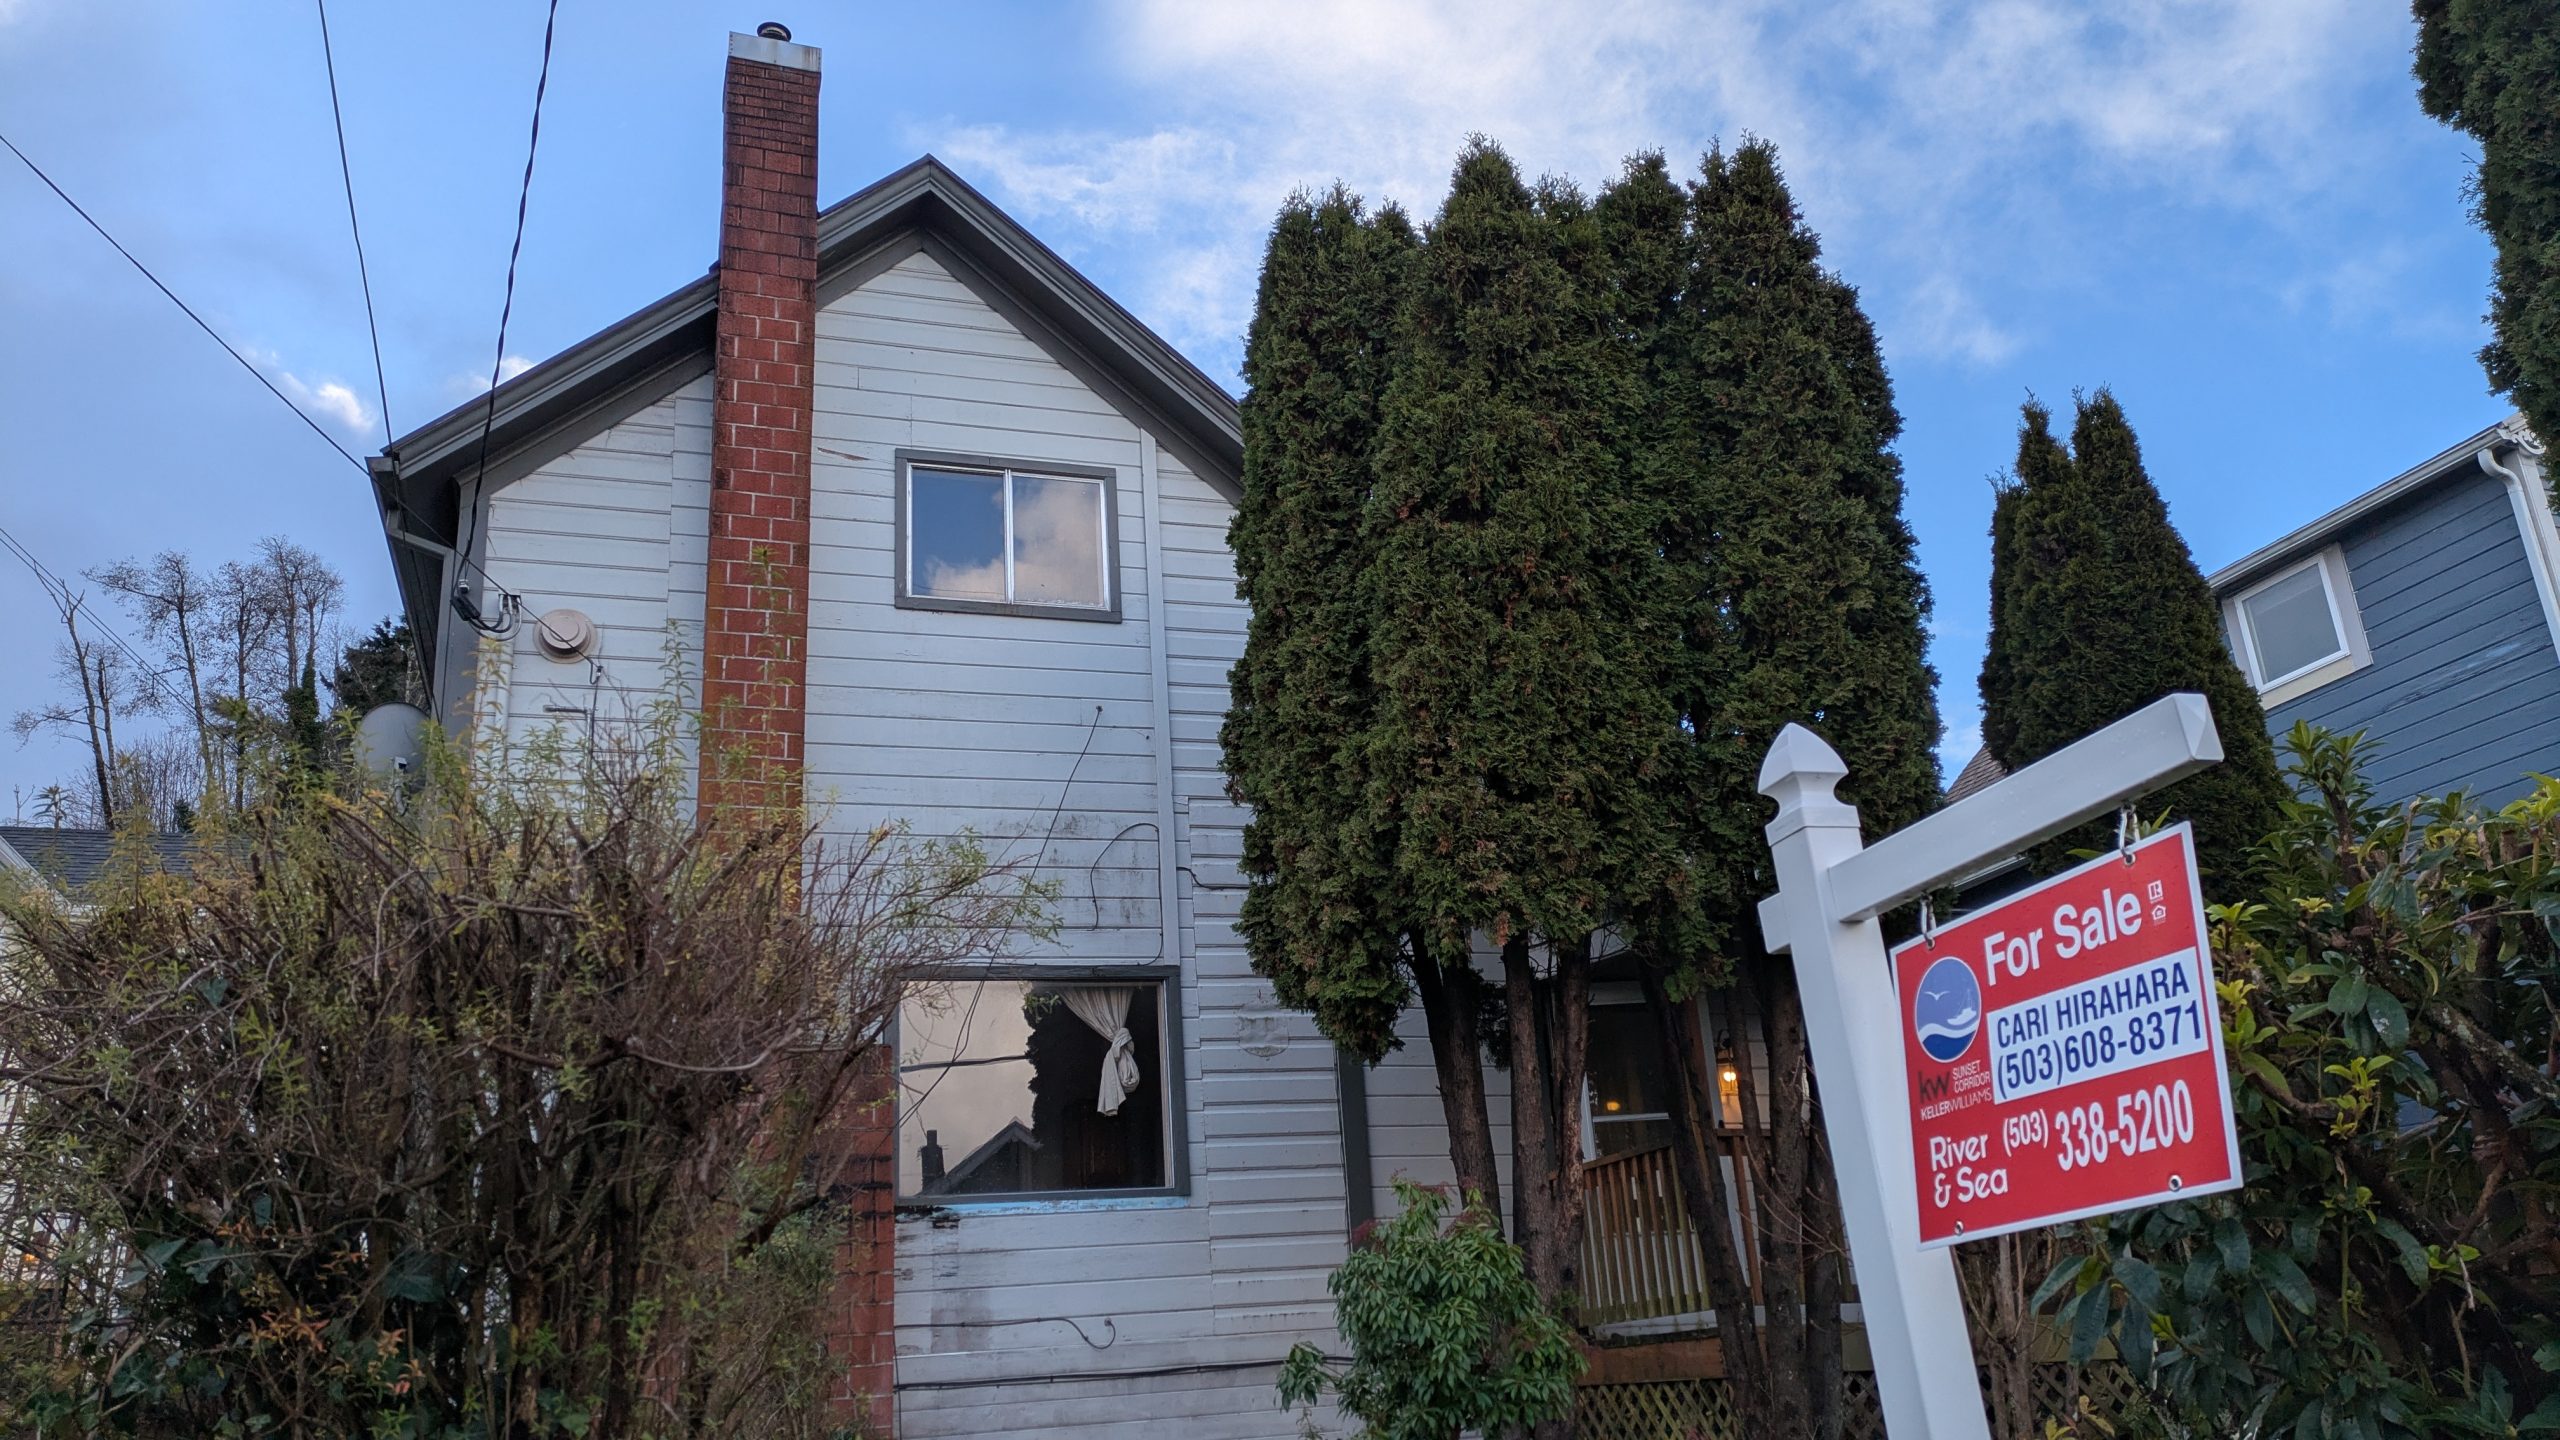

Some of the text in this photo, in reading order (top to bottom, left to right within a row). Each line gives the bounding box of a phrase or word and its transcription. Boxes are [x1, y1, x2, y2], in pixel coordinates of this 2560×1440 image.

[1984, 887, 2142, 986] For Sale
[1997, 961, 2189, 1049] CARI HIRAHARA
[1952, 1060, 1980, 1081] SUNSET
[1998, 1000, 2202, 1100] (503)608-8371
[1918, 1071, 1950, 1104] kw
[1954, 1071, 1991, 1094] CORRIDOR
[2002, 1080, 2194, 1171] (503) 338-5200
[1929, 1132, 1988, 1172] River
[1934, 1167, 2008, 1208] & Sea
